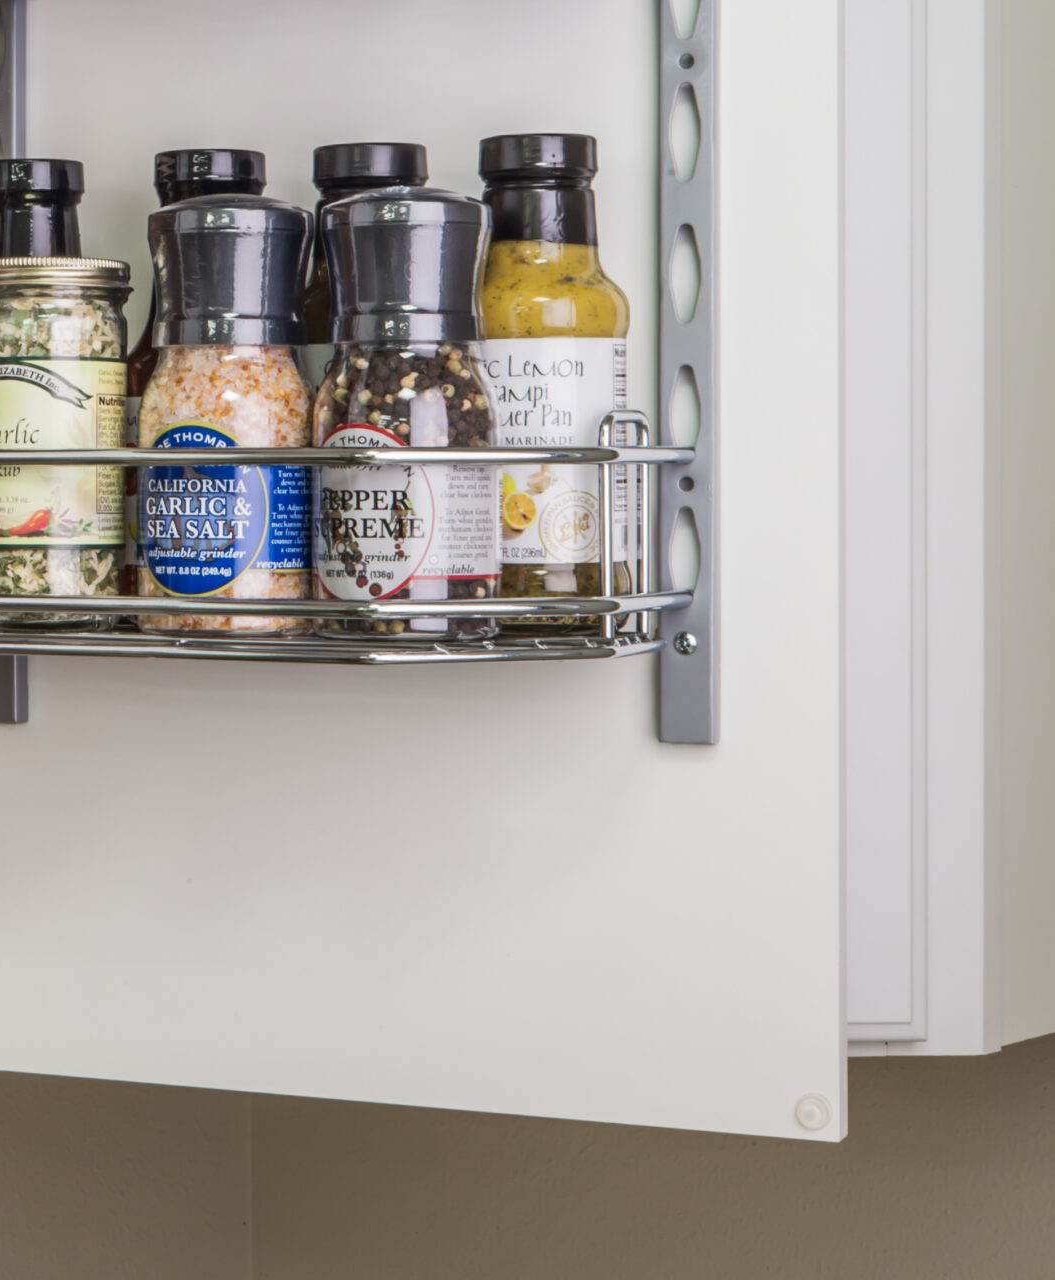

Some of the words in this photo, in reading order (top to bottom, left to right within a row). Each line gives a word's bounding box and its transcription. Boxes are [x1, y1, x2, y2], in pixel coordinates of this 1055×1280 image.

[45, 378, 60, 393] Inc.
[498, 384, 548, 408] ampi
[542, 404, 573, 426] Pan
[506, 436, 575, 446] MARINADE
[278, 470, 293, 478] Turn
[148, 479, 248, 493] CALIFORNIA
[281, 479, 296, 487] down
[321, 487, 412, 511] PEPPER
[146, 497, 226, 516] GARLIC
[233, 496, 252, 517] &
[278, 503, 285, 511] To
[272, 512, 287, 520] Turn
[147, 519, 181, 538] SEA
[186, 519, 250, 538] SALT
[314, 518, 426, 538] SUPREME
[148, 546, 197, 561] adjustable
[198, 547, 247, 562] grinder
[364, 551, 411, 565] grinder
[511, 547, 520, 557] OZ
[521, 546, 547, 559] (296mL)
[155, 566, 166, 574] NET
[166, 566, 177, 574] WT.
[178, 566, 189, 575] 8.8
[190, 566, 200, 575] OZ
[256, 557, 304, 572] recyclable
[422, 563, 475, 576] recyclable
[326, 570, 336, 578] NET
[370, 569, 395, 580] (136g)
